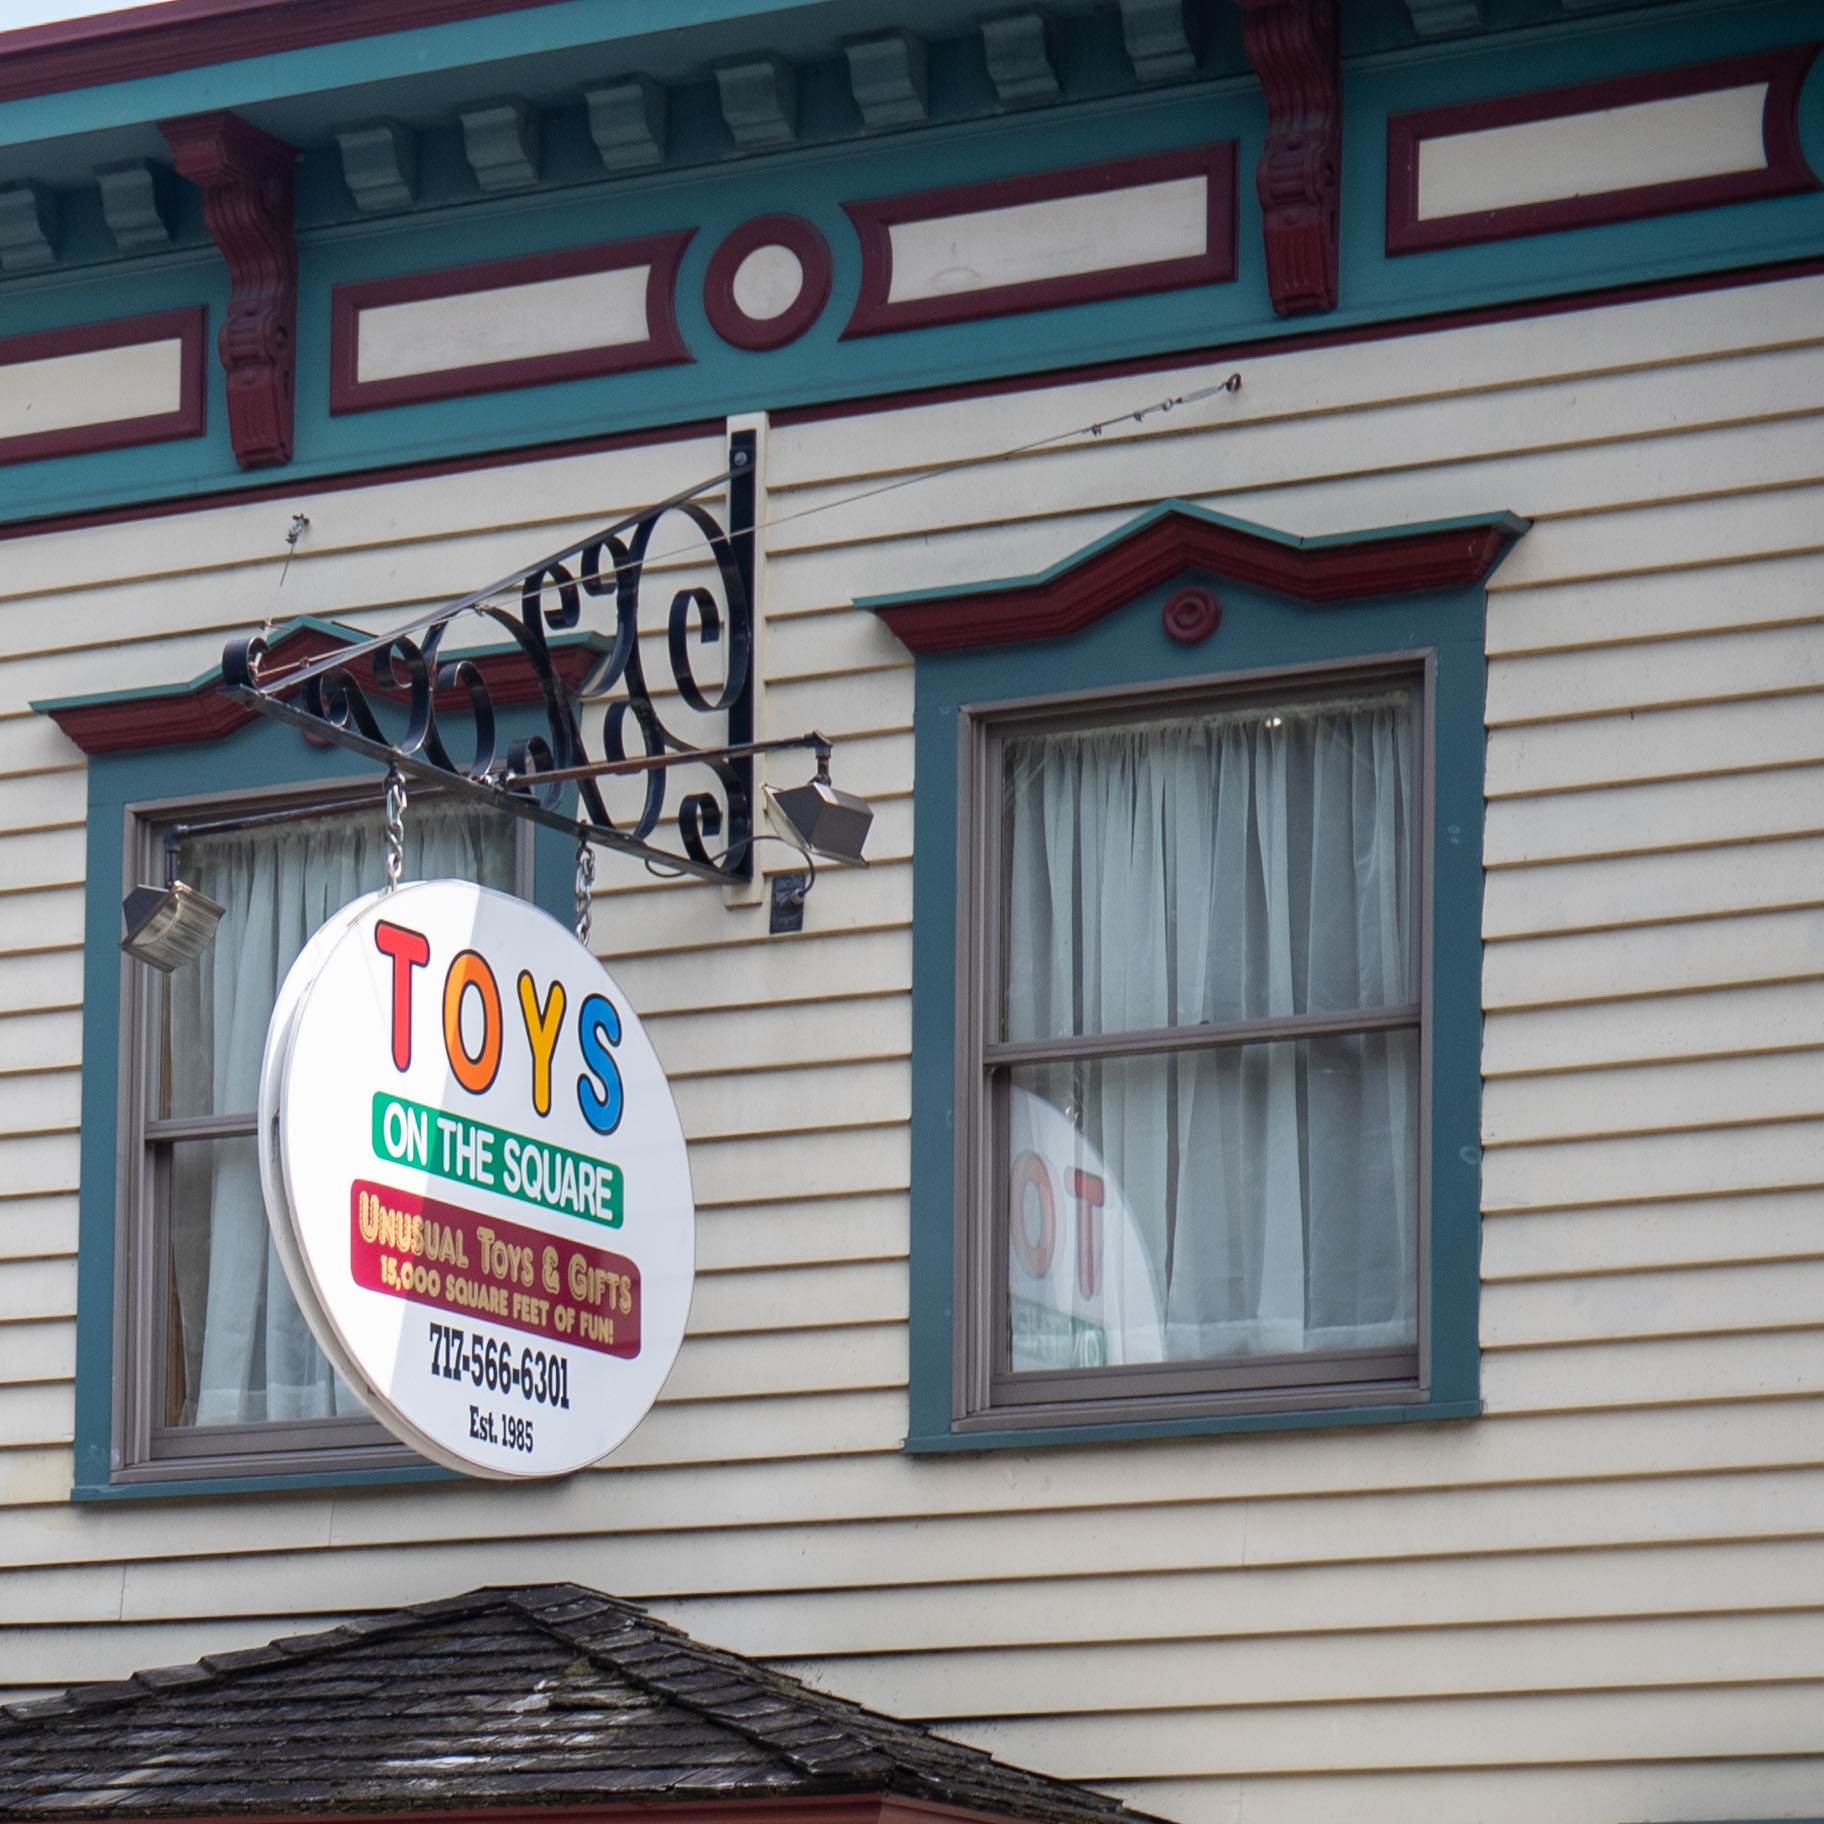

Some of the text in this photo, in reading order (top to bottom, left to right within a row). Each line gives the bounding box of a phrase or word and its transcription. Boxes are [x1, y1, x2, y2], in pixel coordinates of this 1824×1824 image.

[374, 919, 622, 1136] TOYS
[383, 1102, 614, 1221] ON THE SQUARE
[380, 1254, 614, 1345] 15,000 SQUARE FEET OF FUN!
[542, 1246, 560, 1294] &
[429, 1322, 570, 1409] 717-566-6301
[469, 1405, 534, 1453] Est. 1985
